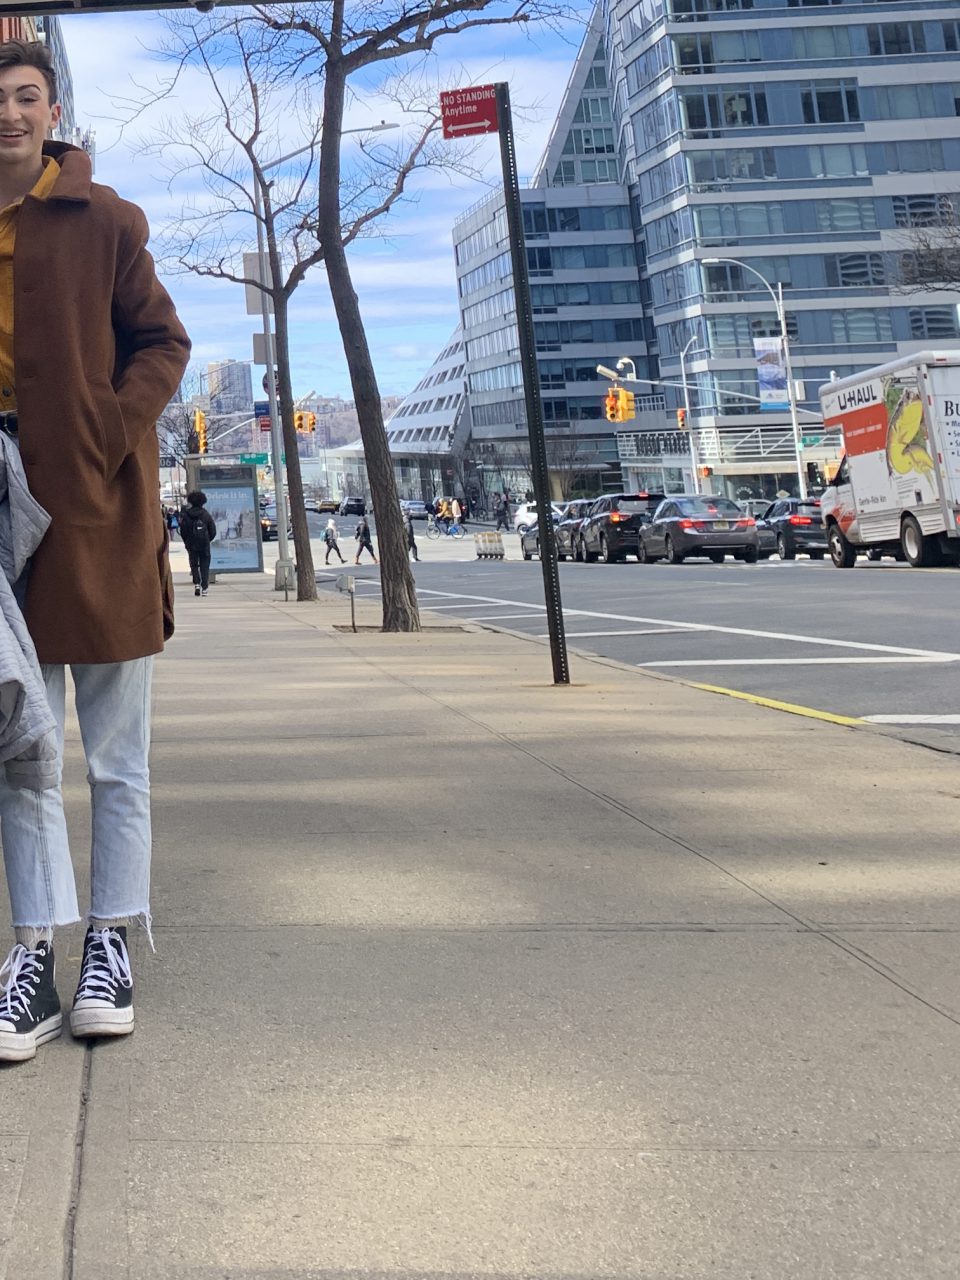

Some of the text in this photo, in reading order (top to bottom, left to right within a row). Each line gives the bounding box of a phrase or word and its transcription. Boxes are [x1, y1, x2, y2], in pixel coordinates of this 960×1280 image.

[443, 89, 496, 105] NO STANDING
[445, 104, 478, 117] Anytime
[837, 384, 878, 410] U-HAUL
